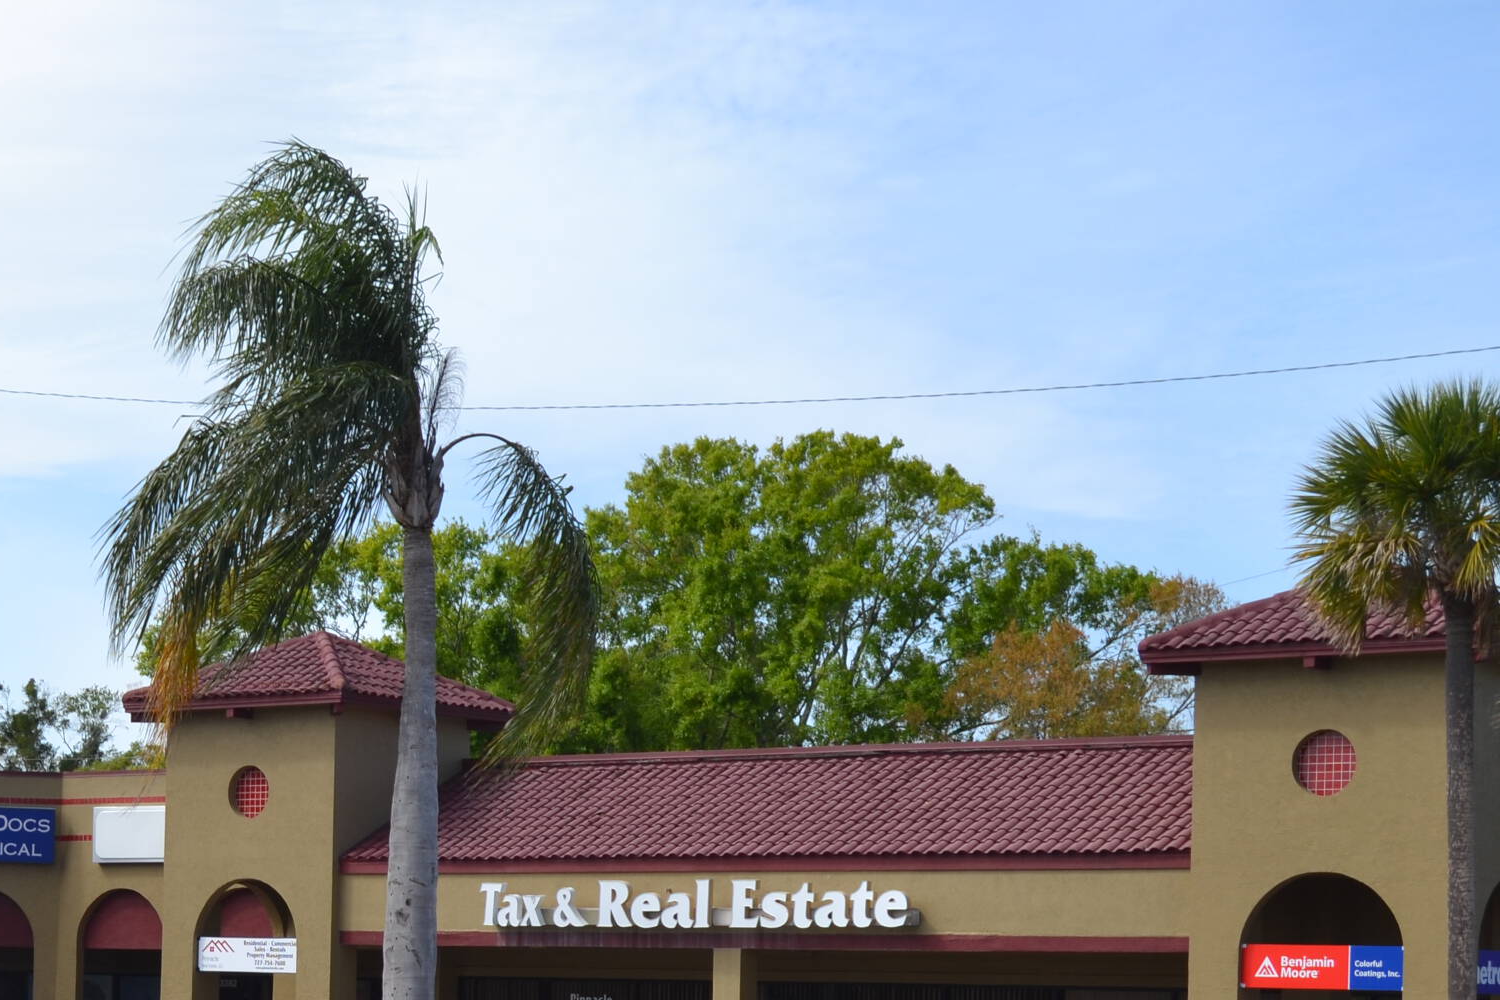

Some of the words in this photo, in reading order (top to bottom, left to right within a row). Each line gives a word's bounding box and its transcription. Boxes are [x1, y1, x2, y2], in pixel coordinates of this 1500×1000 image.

[479, 882, 546, 928] Tax
[553, 886, 588, 928] &
[596, 879, 714, 930] Real
[729, 879, 910, 930] Estate
[271, 940, 297, 948] Commercia
[1280, 955, 1335, 969] Benjamin
[1354, 959, 1383, 968] Colorful
[1280, 967, 1319, 979] Moore
[1354, 969, 1387, 979] Coatings,
[1387, 970, 1401, 978] Inc.
[1477, 960, 1500, 985] etr
